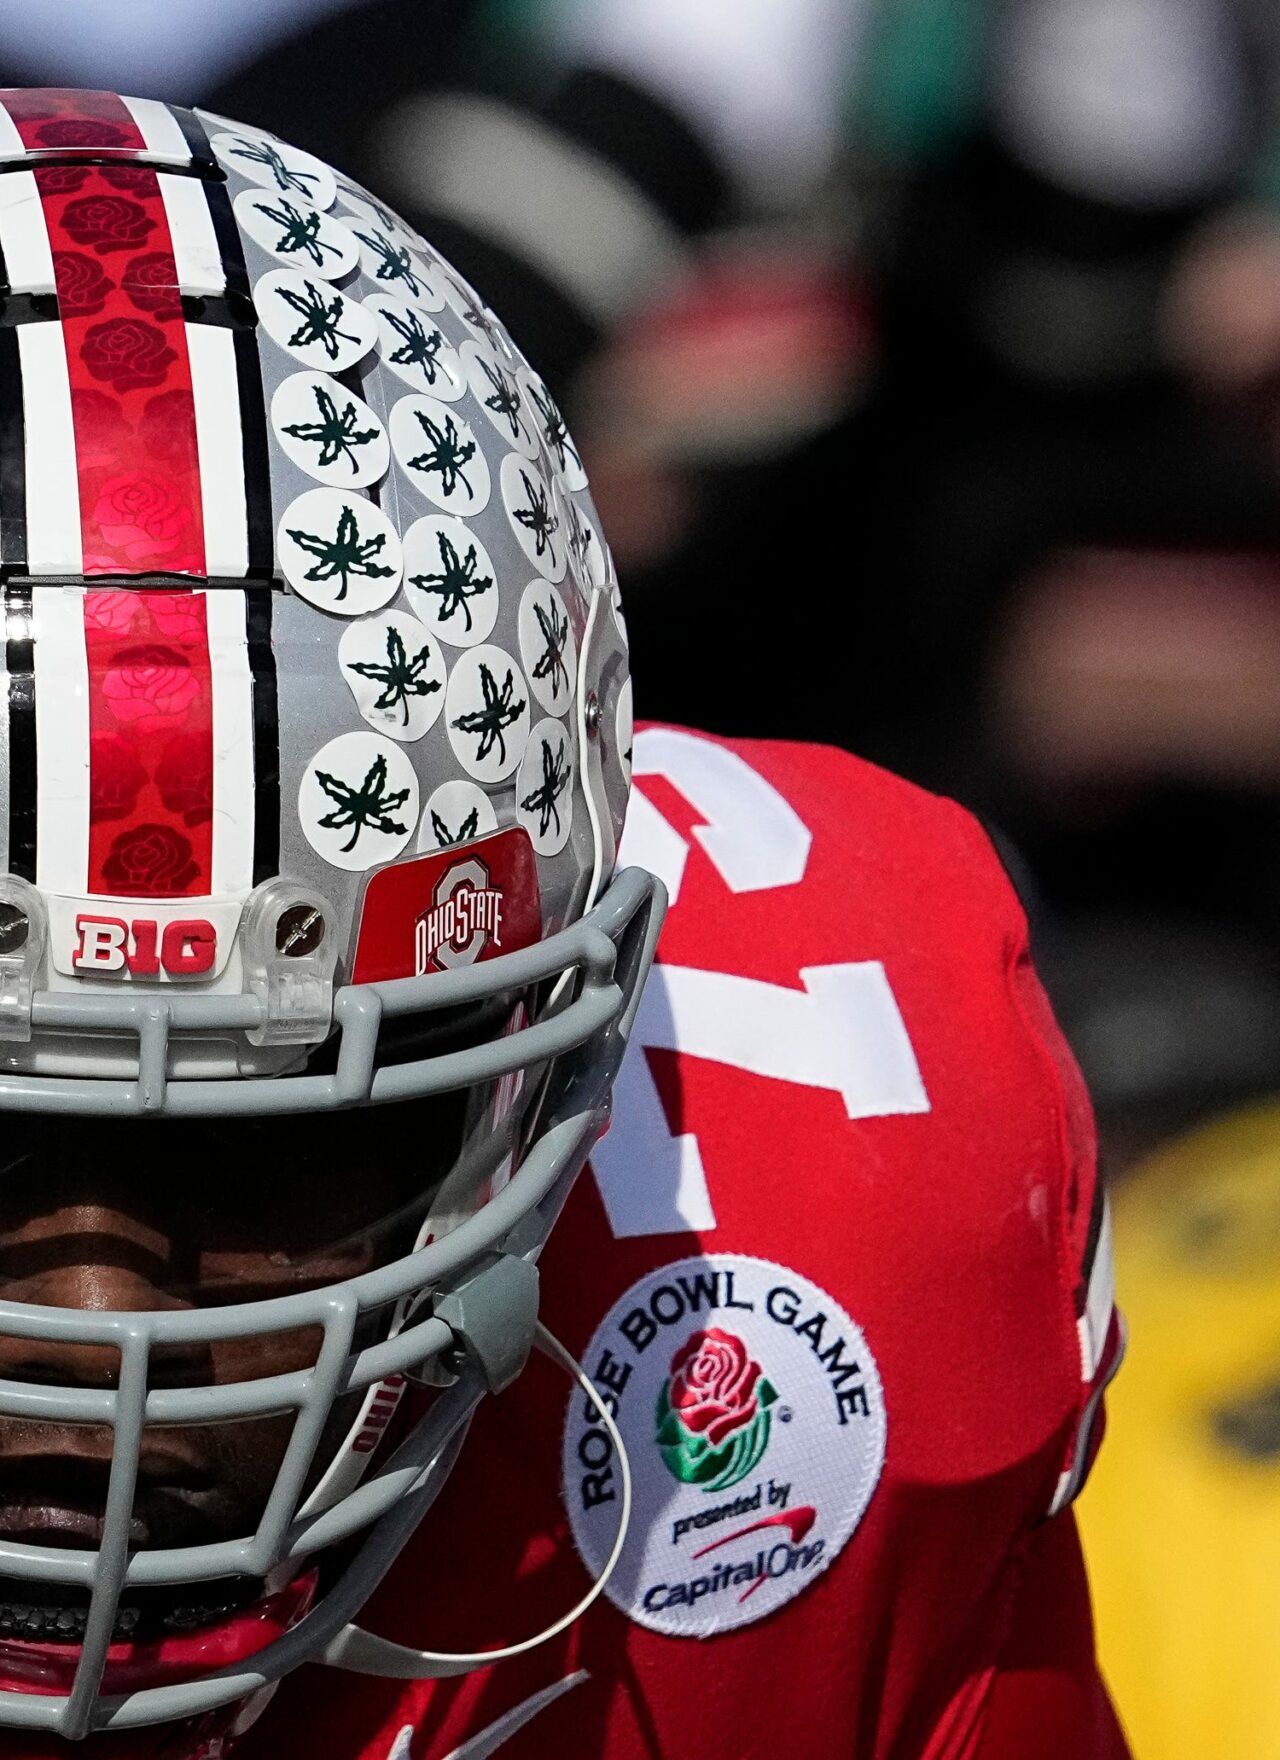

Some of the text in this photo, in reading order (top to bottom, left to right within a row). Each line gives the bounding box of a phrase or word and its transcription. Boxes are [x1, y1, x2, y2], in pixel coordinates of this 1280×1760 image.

[578, 1271, 871, 1511] ROSE BOWL GAME
[671, 1478, 792, 1545] presented by
